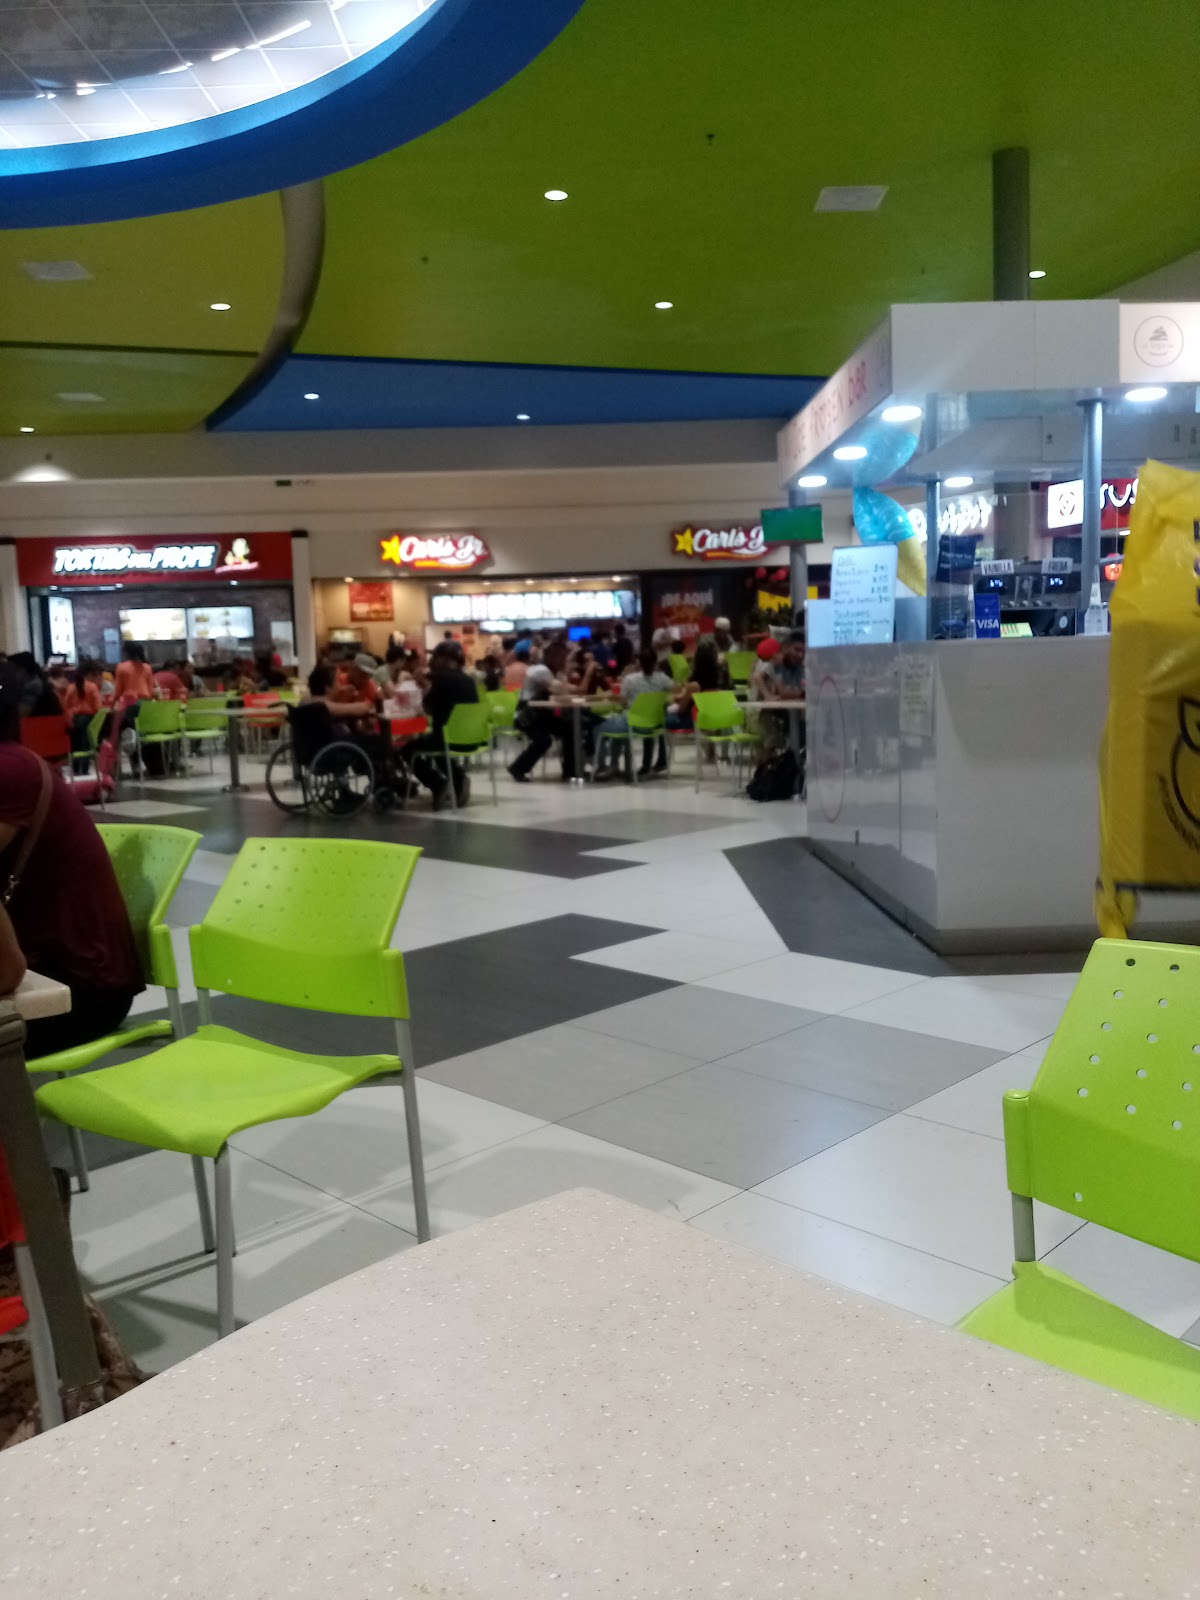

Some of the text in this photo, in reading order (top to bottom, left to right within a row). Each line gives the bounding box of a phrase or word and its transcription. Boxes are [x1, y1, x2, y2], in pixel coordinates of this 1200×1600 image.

[399, 535, 455, 562] Carl's
[693, 525, 764, 552] Carl's J
[55, 547, 131, 572] TORTAS
[150, 545, 216, 569] PROFE
[976, 619, 999, 630] VISA
